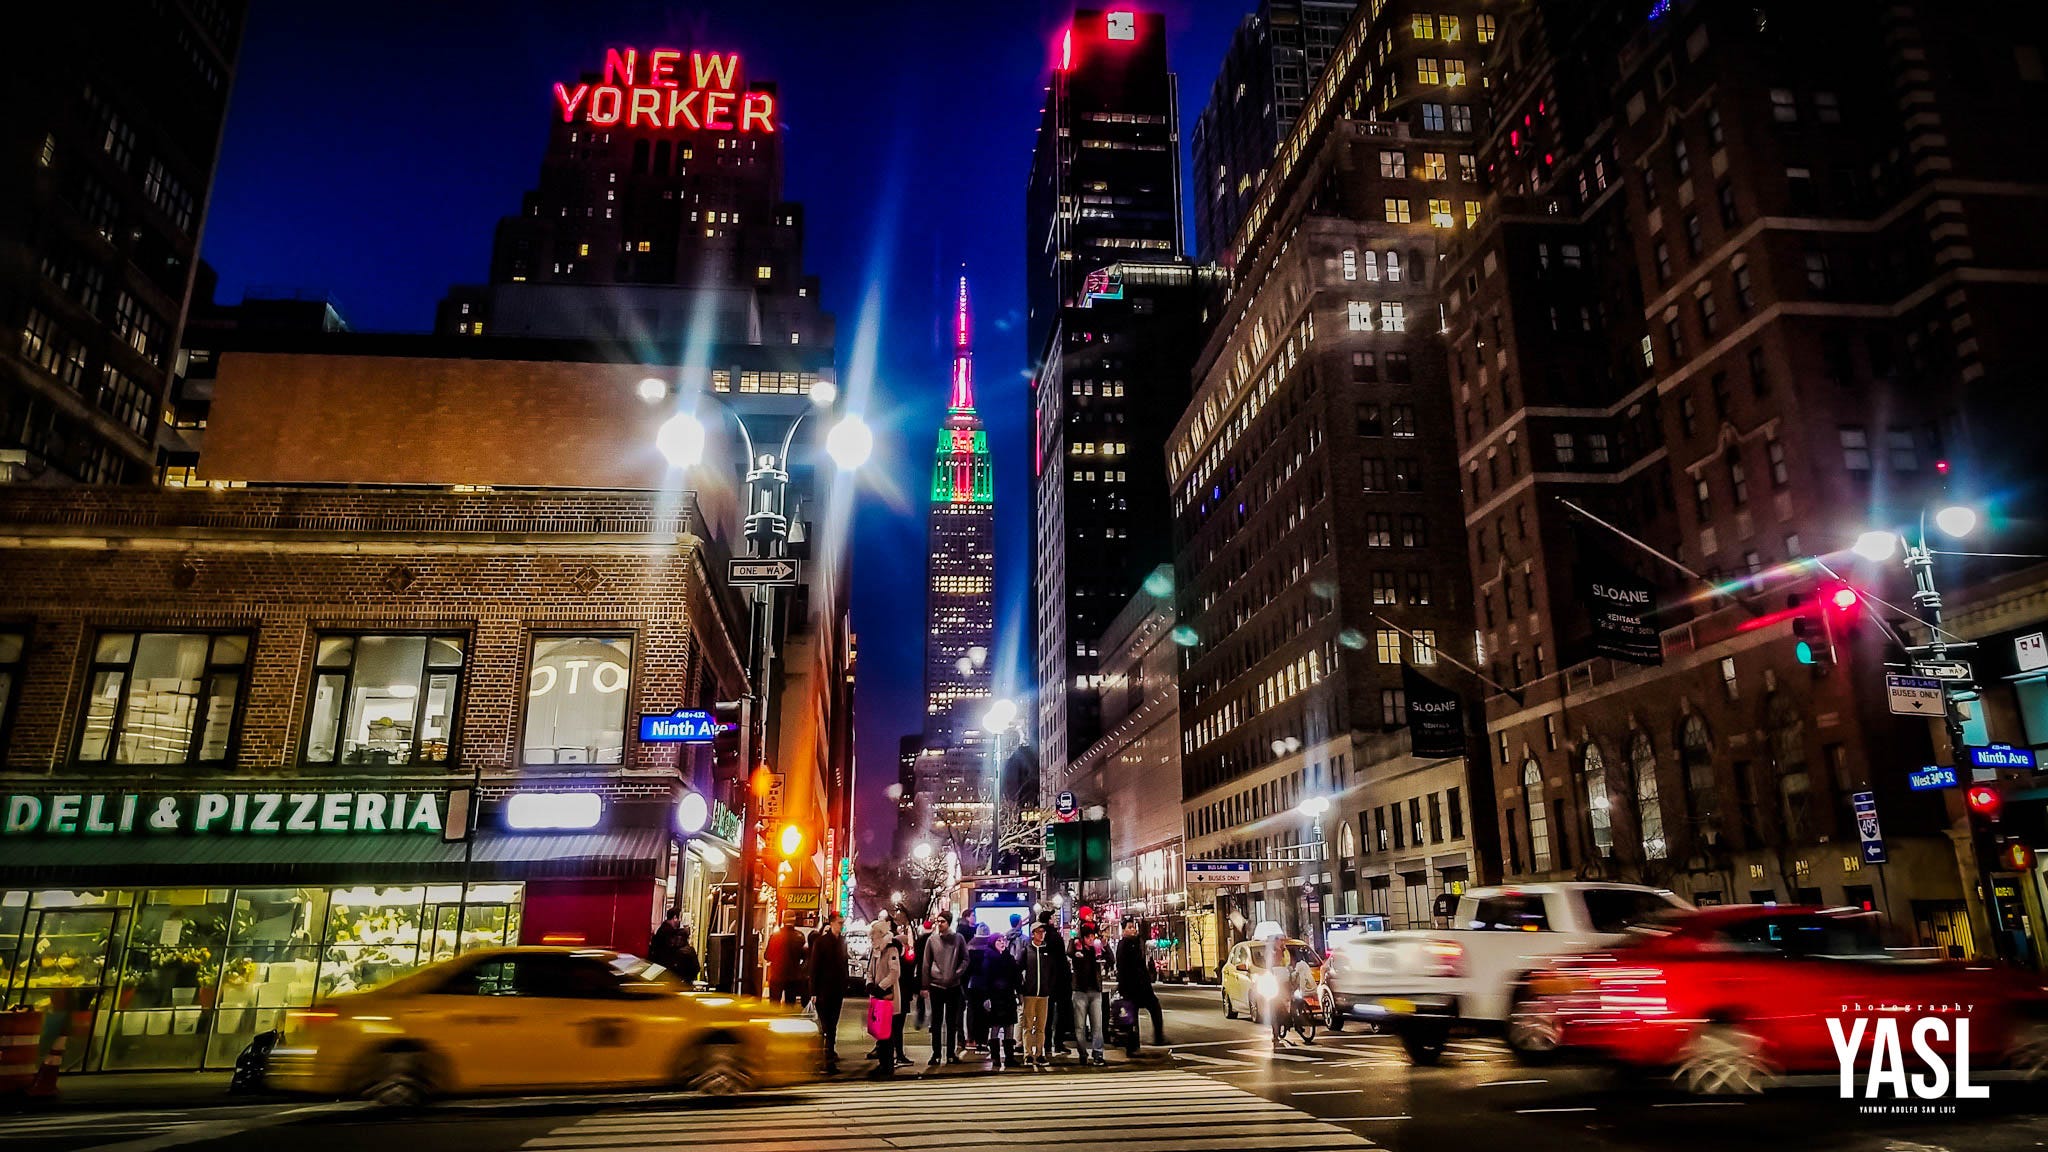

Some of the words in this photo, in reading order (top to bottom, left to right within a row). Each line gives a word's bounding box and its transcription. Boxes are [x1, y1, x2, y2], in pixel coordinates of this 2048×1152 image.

[604, 47, 738, 90] NEW
[553, 81, 775, 133] YORKER
[739, 566, 758, 575] ONE
[766, 566, 787, 575] WAY
[1592, 583, 1650, 604] SLOANE
[1606, 613, 1642, 625] RENTALS
[1901, 678, 1916, 687] BUS
[1917, 679, 1939, 688] LANE
[1892, 688, 1917, 698] BUSES
[1919, 690, 1940, 699] ONLY
[1412, 701, 1457, 713] SLOANE
[652, 719, 696, 737] Ninth
[698, 720, 730, 737] Ave
[1978, 751, 2007, 764] Ninth
[2009, 752, 2029, 765] Ave
[1911, 773, 1931, 787] West
[1944, 771, 1955, 783] St
[5, 794, 138, 833] DELI
[148, 796, 181, 829] &
[195, 792, 443, 832] PIZZERIA
[1861, 818, 1878, 835] 495
[1750, 864, 1764, 878] BH
[1843, 857, 1859, 872] BH
[1208, 874, 1226, 882] BUSES
[1227, 874, 1240, 882] ONLY
